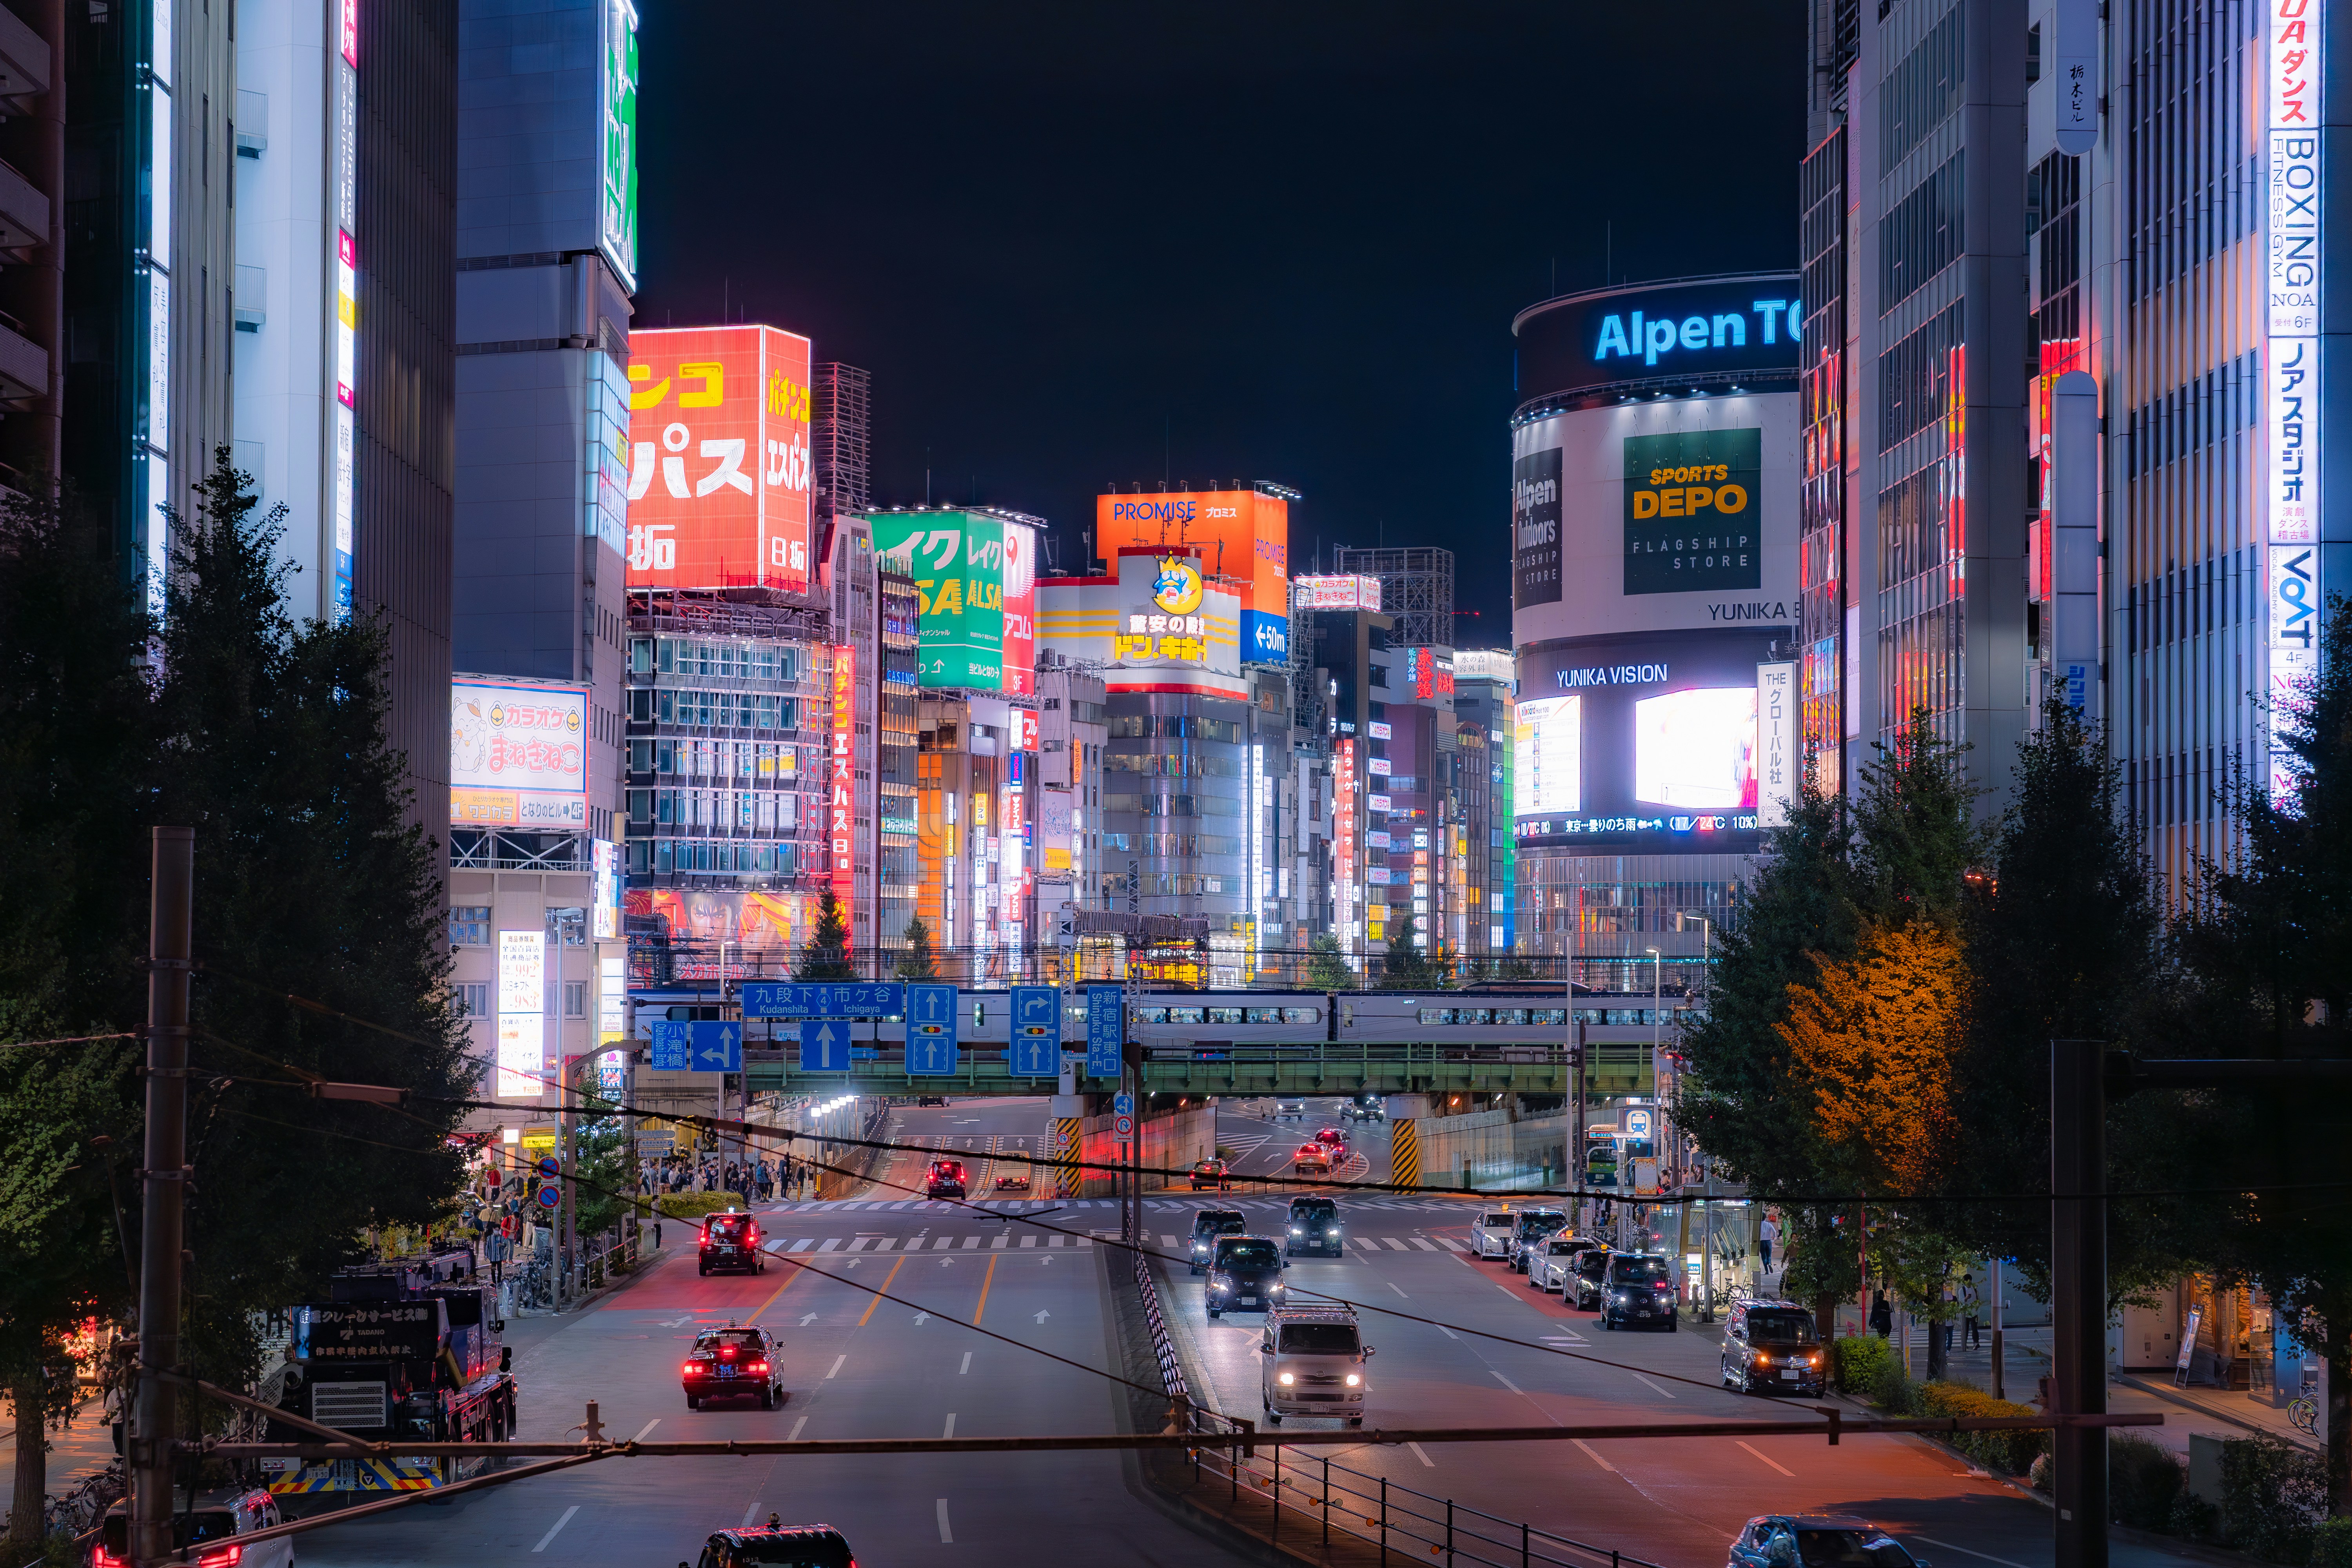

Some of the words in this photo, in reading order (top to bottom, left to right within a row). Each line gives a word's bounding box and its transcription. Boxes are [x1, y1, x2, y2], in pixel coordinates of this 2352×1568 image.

[2069, 64, 2084, 122] 栃木ビル
[2273, 138, 2284, 229] FITNESS
[2286, 138, 2315, 287] BOXING
[2273, 236, 2284, 278] GYM
[2272, 294, 2316, 307] NOA
[2275, 318, 2292, 327] 受付
[2294, 316, 2312, 328] 6F
[1595, 312, 1746, 365] Alpen
[768, 368, 810, 424] パチンコ
[339, 423, 349, 454] 新宿
[337, 455, 351, 488] 桜十字
[767, 432, 809, 492] エスパス
[1650, 465, 1728, 485] SPORTS
[1516, 477, 1556, 517] Alpen
[1634, 485, 1748, 519] DEPO
[1114, 501, 1196, 520] PROMISE
[1205, 507, 1237, 518] プロミス
[2282, 506, 2305, 517] 演劇
[2278, 518, 2308, 529] ダンス
[1517, 520, 1556, 551] Outdoors
[1634, 536, 1748, 554] FLAGSHIP
[2278, 530, 2310, 541] 稽古場
[340, 554, 345, 568] 5F
[968, 535, 1002, 570] レイク
[1256, 538, 1285, 564] PROMISE
[1516, 550, 1557, 572] FLAGSHIP
[1273, 565, 1285, 578] プロミス
[1674, 555, 1748, 570] STORE
[1321, 579, 1349, 588] カラオケ
[1526, 570, 1557, 585] STORE
[966, 580, 1002, 612] ALSA
[1315, 591, 1356, 603] まねきねこ
[1708, 602, 1787, 621] YUNIKA
[2272, 612, 2278, 622] OF
[1004, 613, 1033, 640] アコム
[1129, 615, 1205, 636] 驚安の殿堂
[1266, 624, 1285, 653] 50m
[1461, 655, 1485, 663] 水の森
[2286, 652, 2303, 664] 4F
[887, 669, 915, 686] CASINO
[969, 662, 995, 678] 当ビルとなり
[1416, 647, 1435, 699] 東海苑
[1557, 667, 1607, 688] YUNIKA
[1610, 664, 1668, 684] VISION
[1766, 673, 1786, 684] THE
[835, 657, 849, 728] パチンコ
[1013, 675, 1023, 691] 3F
[506, 706, 564, 728] カラオケ
[1769, 689, 1782, 785] グローバル社
[489, 733, 581, 773] まねきねこ
[1344, 746, 1353, 791] カラオケ
[833, 733, 849, 832] エスパス
[468, 804, 513, 819] ワンカラ
[521, 802, 562, 818] となりのビル
[572, 803, 583, 819] 4F
[1762, 803, 1780, 817] global
[756, 987, 814, 1004] 九段下
[821, 996, 826, 1004] 4
[760, 1005, 809, 1014] Kudanshita
[844, 1005, 880, 1015] Ichigaya
[1091, 993, 1102, 1033] Shinjuku
[655, 1024, 666, 1053] Otakibashi
[1103, 990, 1117, 1072] 新宿駅東口
[667, 1025, 683, 1068] 小滝橋
